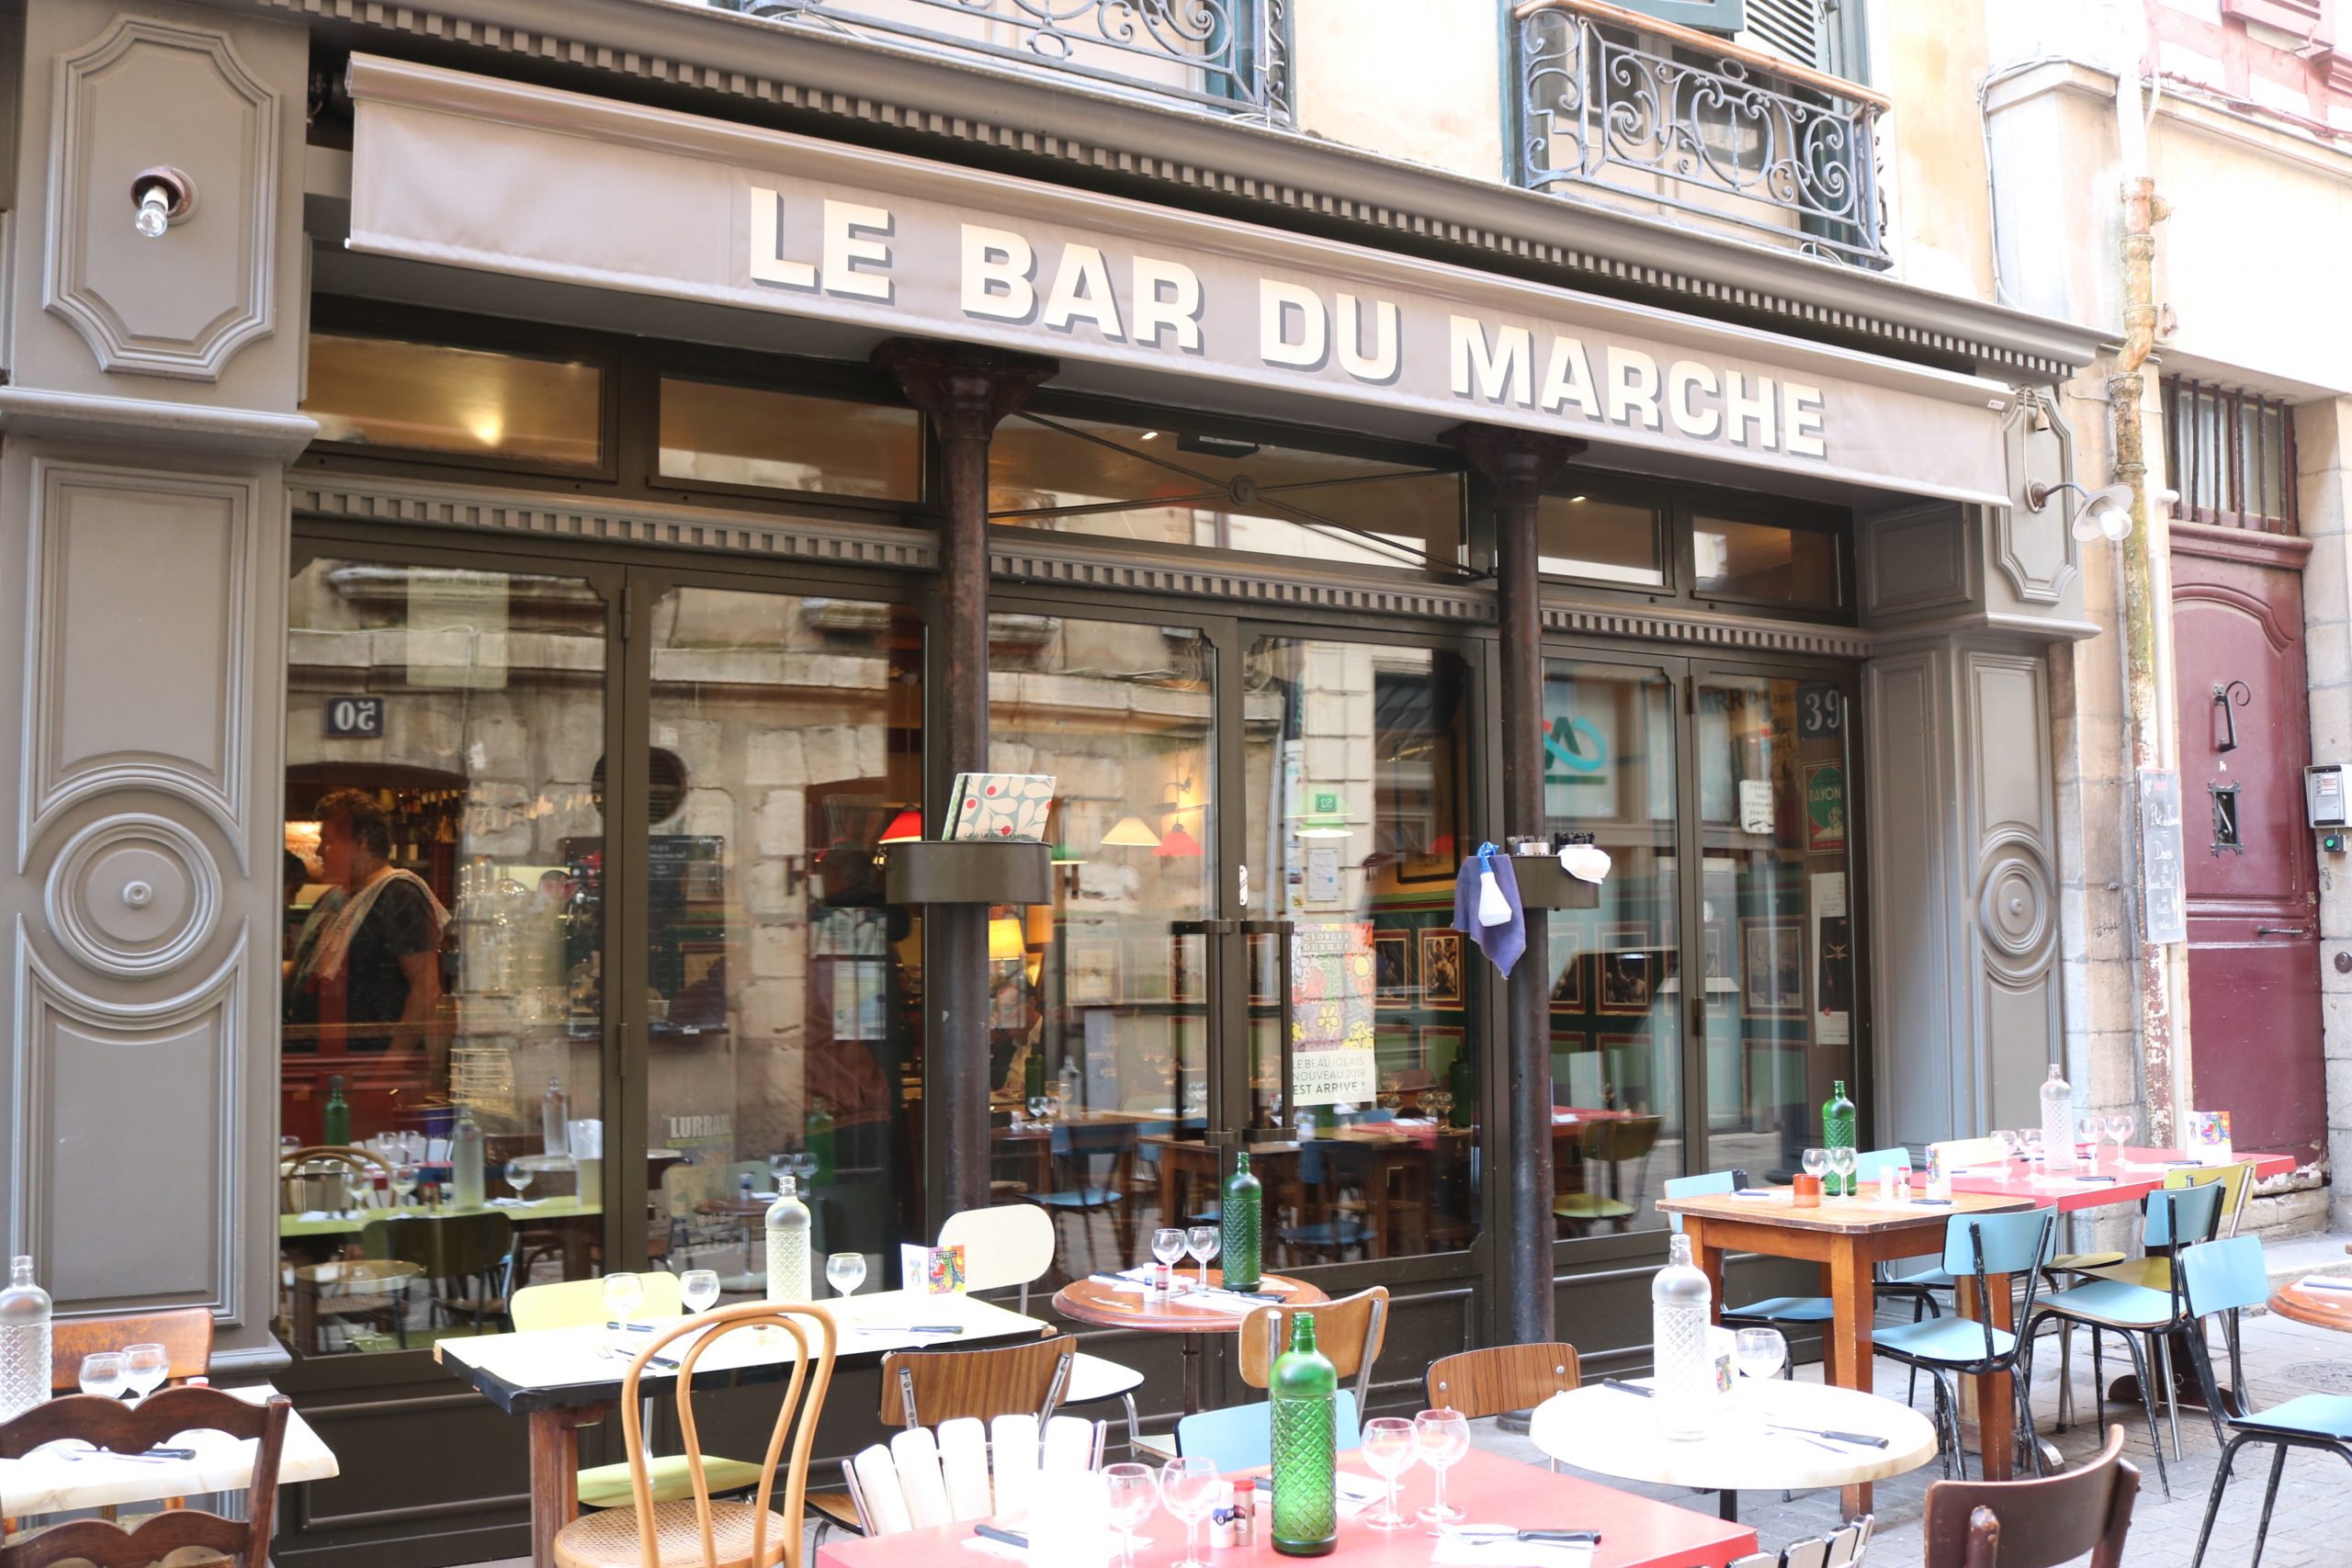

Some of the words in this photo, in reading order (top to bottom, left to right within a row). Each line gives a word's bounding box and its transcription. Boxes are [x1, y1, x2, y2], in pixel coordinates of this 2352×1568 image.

[750, 186, 895, 306] LE
[960, 223, 1204, 355] BAR
[1260, 277, 1402, 387] DU
[1449, 314, 1827, 459] MARCHE
[1805, 690, 1840, 731] 39
[1808, 787, 1841, 802] BAYON
[1305, 932, 1349, 941] GEORGES
[1305, 1057, 1364, 1068] BEAUJOLAIS
[1293, 1070, 1343, 1081] NOUVEAU
[1345, 1069, 1366, 1079] 2018
[1293, 1085, 1312, 1095] EST
